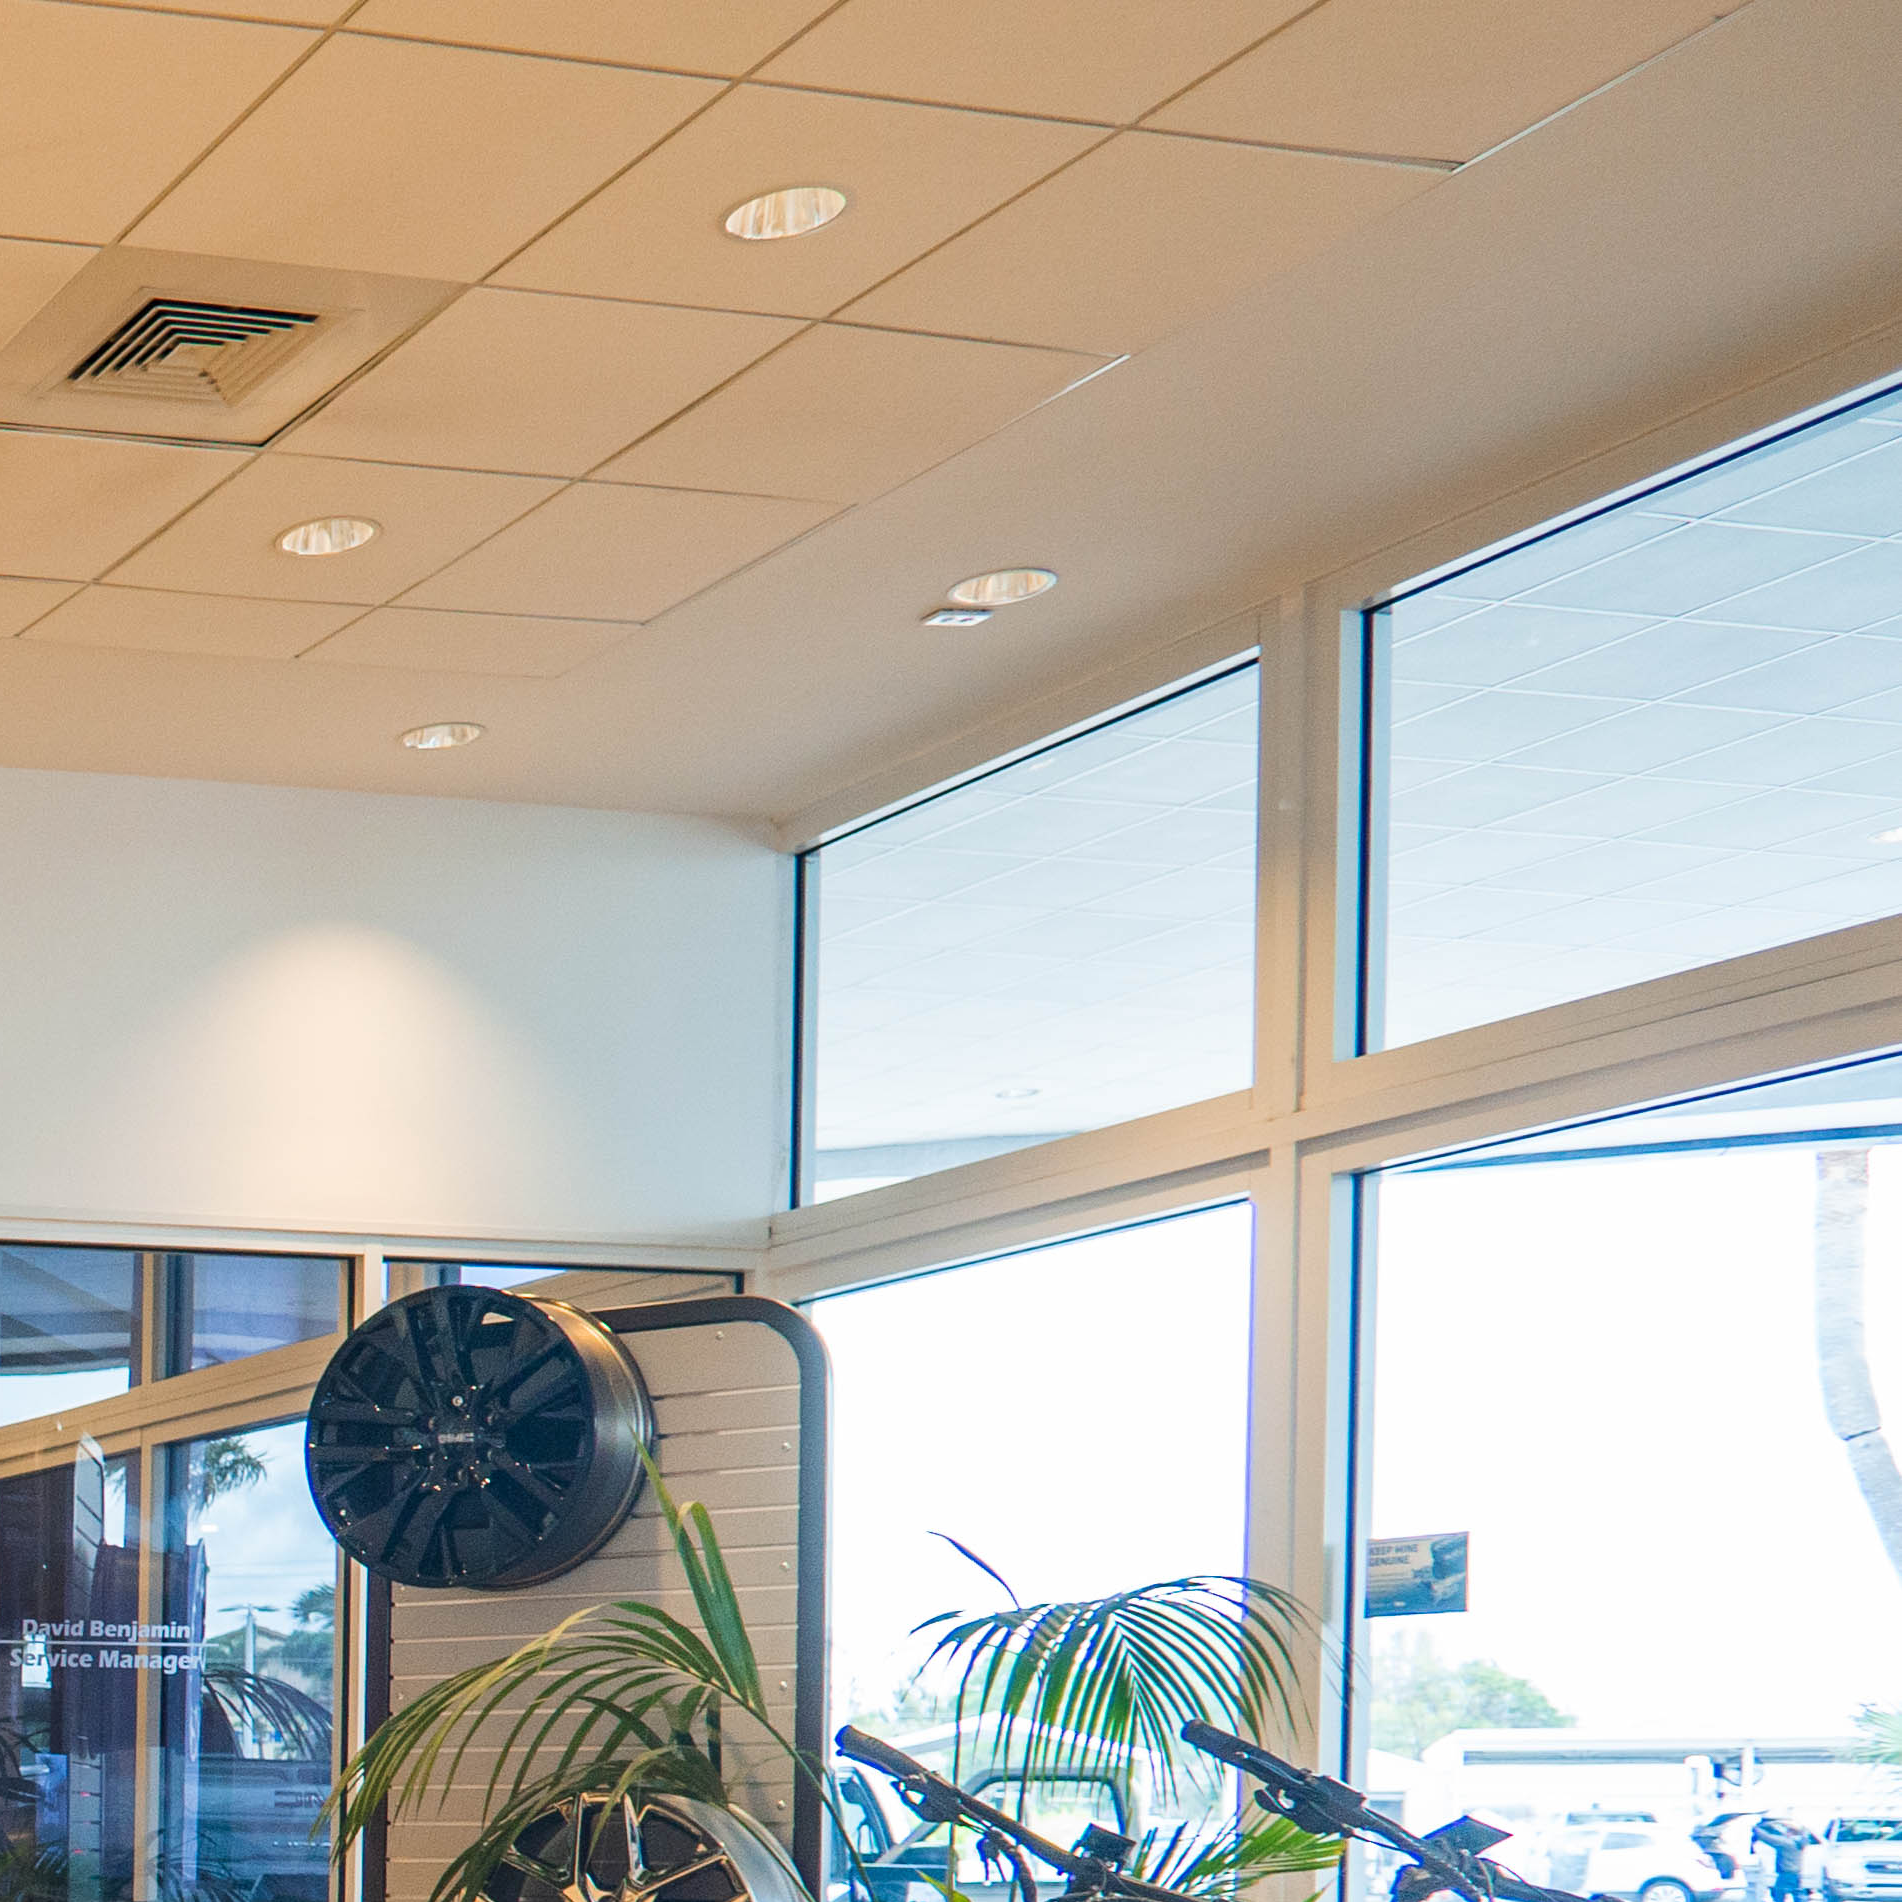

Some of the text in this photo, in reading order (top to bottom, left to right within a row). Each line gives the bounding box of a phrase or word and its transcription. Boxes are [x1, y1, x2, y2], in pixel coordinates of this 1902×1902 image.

[22, 1619, 192, 1643] David Benjamin
[9, 1649, 202, 1675] Service Manager
